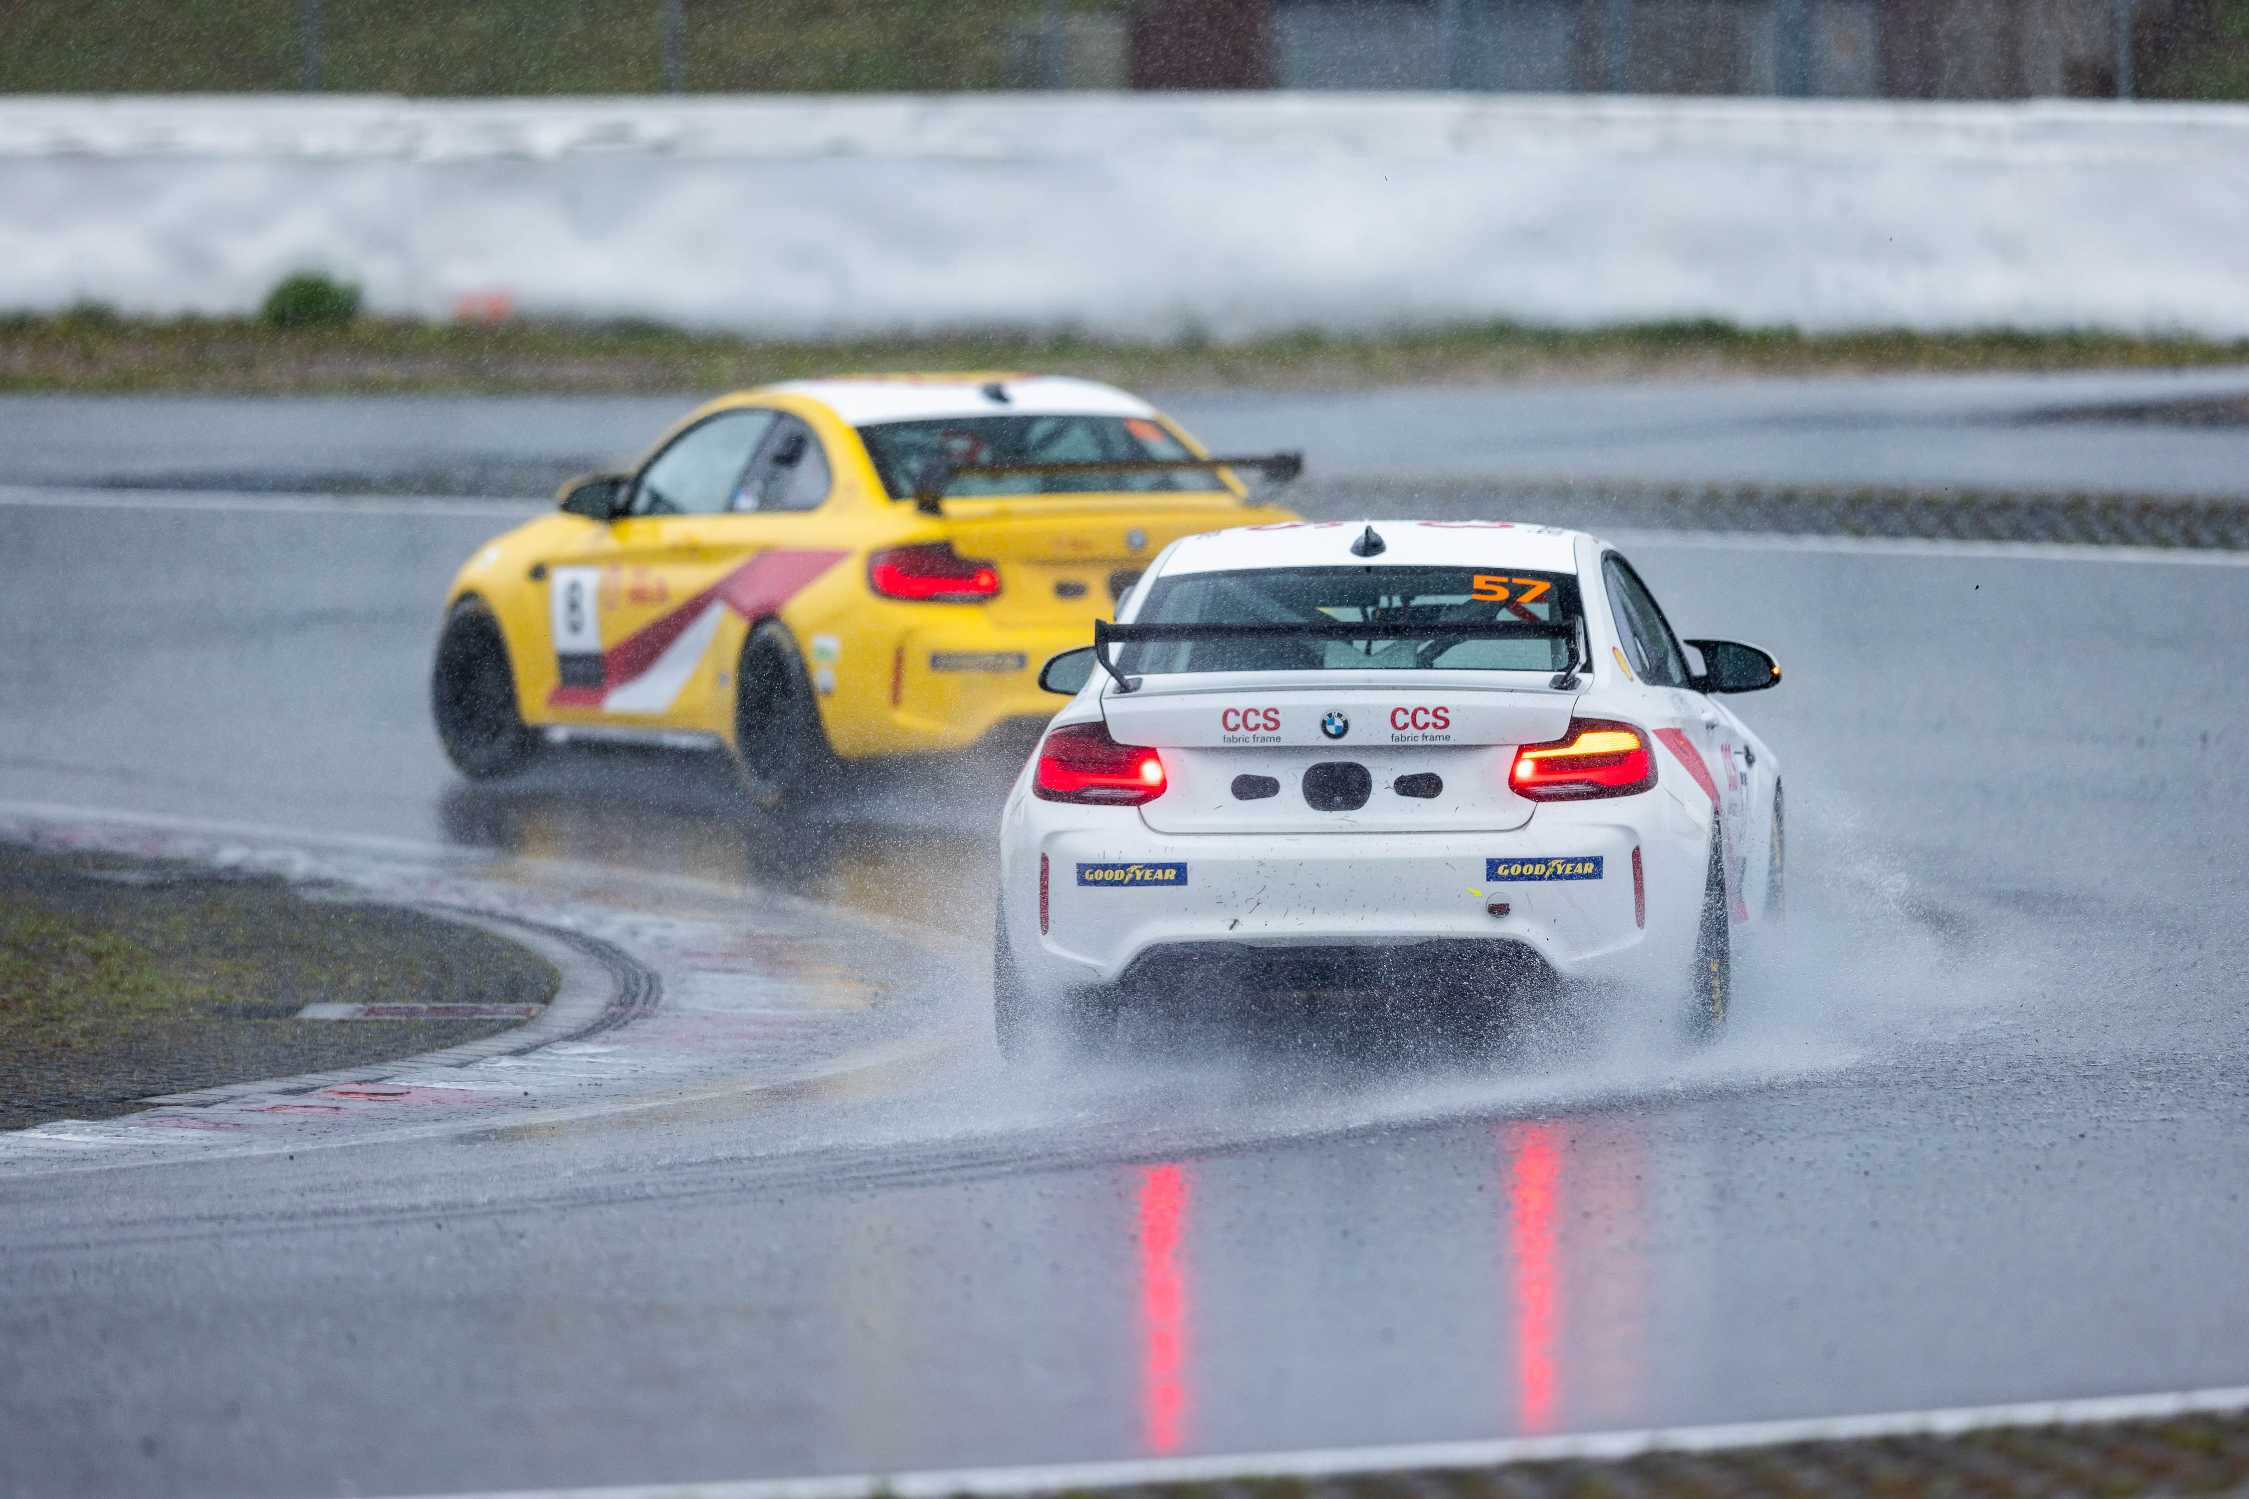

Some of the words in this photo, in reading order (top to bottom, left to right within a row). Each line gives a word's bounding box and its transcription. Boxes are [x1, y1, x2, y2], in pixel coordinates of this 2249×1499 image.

[1471, 574, 1553, 604] 57
[1221, 707, 1281, 732] CCS
[1390, 705, 1451, 731] CCS
[1222, 733, 1250, 744] fabric
[1252, 733, 1281, 744] frame
[1390, 732, 1419, 743] fabric
[1422, 732, 1450, 742] frame
[1084, 865, 1177, 885] GOODYEAR
[1497, 860, 1595, 878] GOODYEAR
